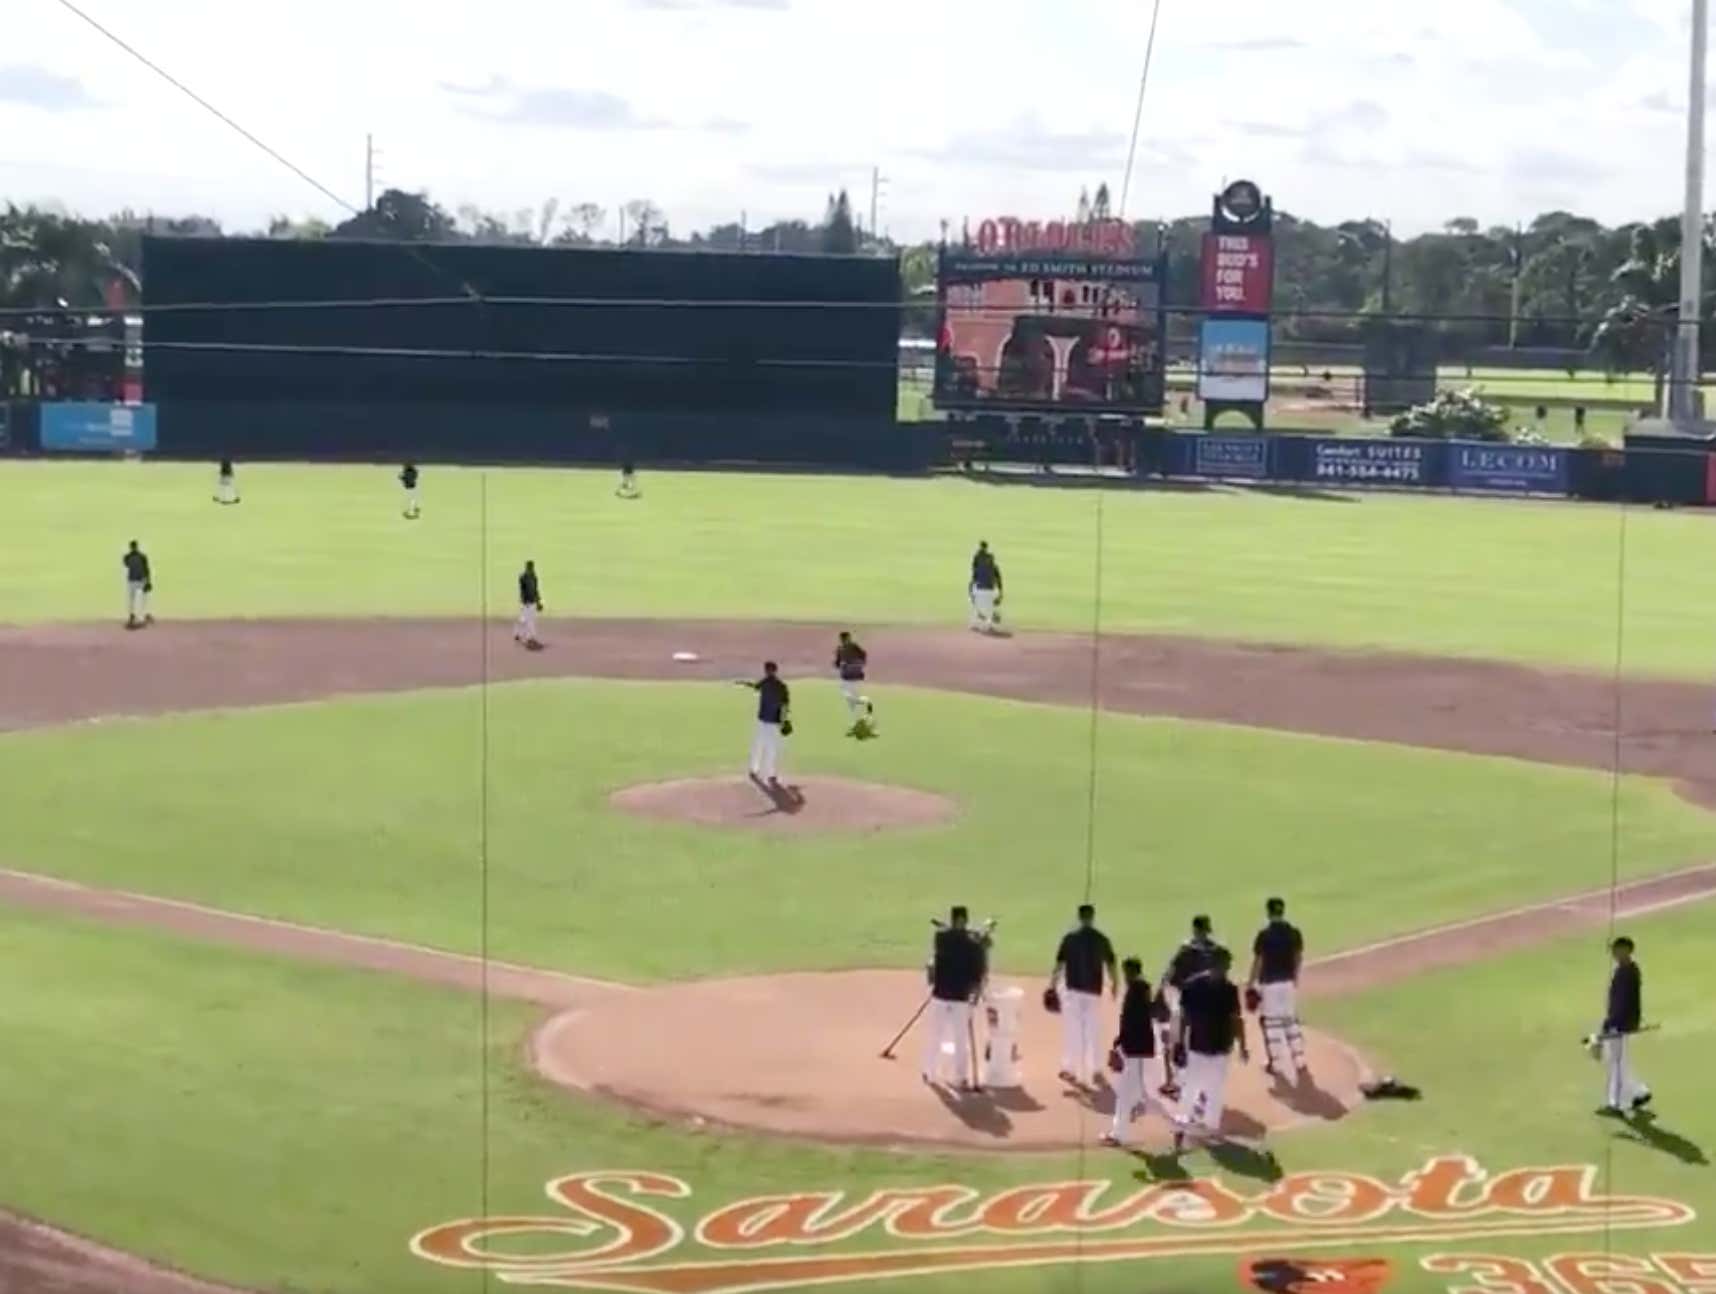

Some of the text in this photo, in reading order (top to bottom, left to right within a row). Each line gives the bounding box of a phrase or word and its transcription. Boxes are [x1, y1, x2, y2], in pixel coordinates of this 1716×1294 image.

[1367, 446, 1421, 459] SUITES
[1461, 449, 1557, 471] LECOM
[409, 1154, 1692, 1268] Sarasota
